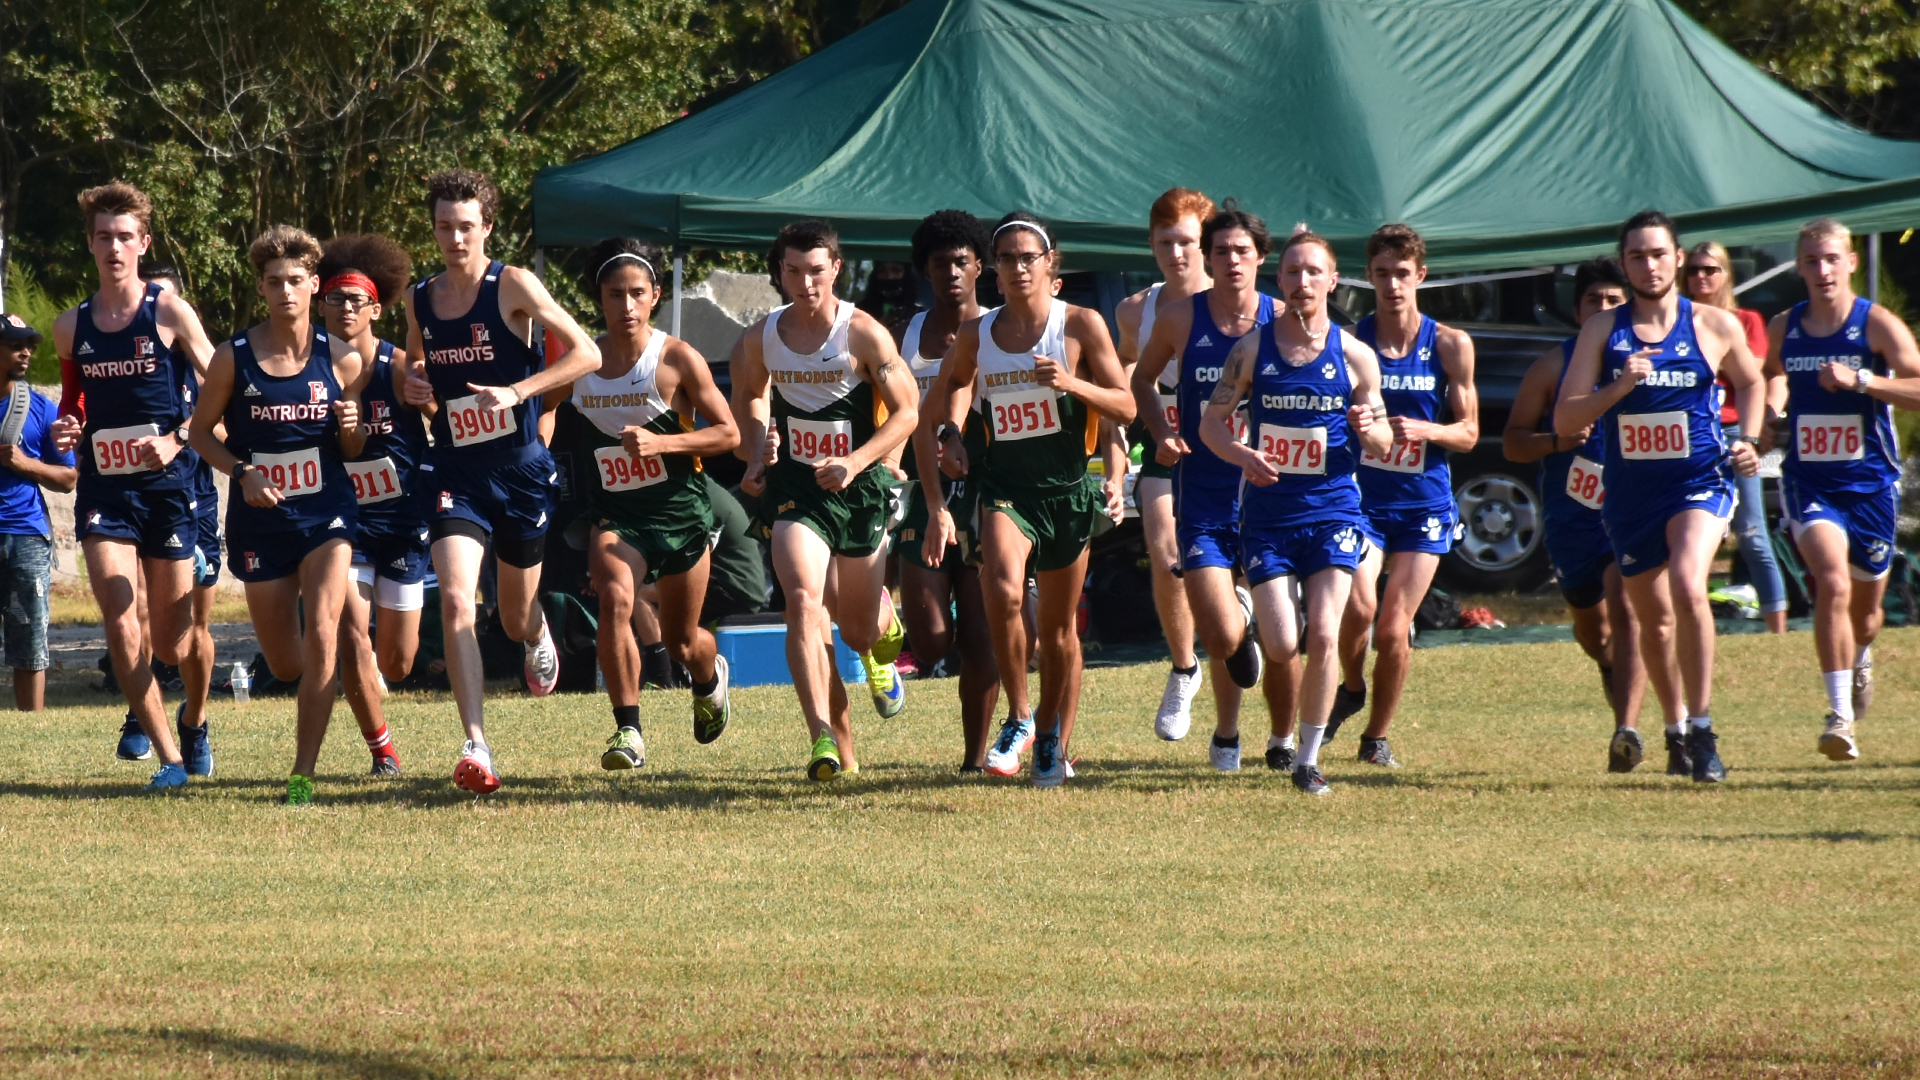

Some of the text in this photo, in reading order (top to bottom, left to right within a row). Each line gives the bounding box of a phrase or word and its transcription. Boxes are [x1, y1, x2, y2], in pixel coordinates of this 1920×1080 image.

[82, 358, 157, 378] PATRIOTS
[429, 345, 494, 365] PATRIOTS
[771, 370, 843, 384] METHODIST
[984, 369, 1036, 388] METHOD
[251, 404, 329, 421] PATRIOTS
[581, 393, 649, 408] METHODIST
[1261, 395, 1344, 411] COUGARS
[994, 399, 1056, 435] 3951
[791, 429, 849, 459] 3948
[1263, 434, 1322, 469] 3879
[1622, 424, 1684, 453] 3880
[1801, 426, 1859, 455] 3876
[96, 438, 143, 469] 390
[349, 468, 395, 500] 911
[601, 457, 662, 486] 3946
[1570, 467, 1606, 504] 38
